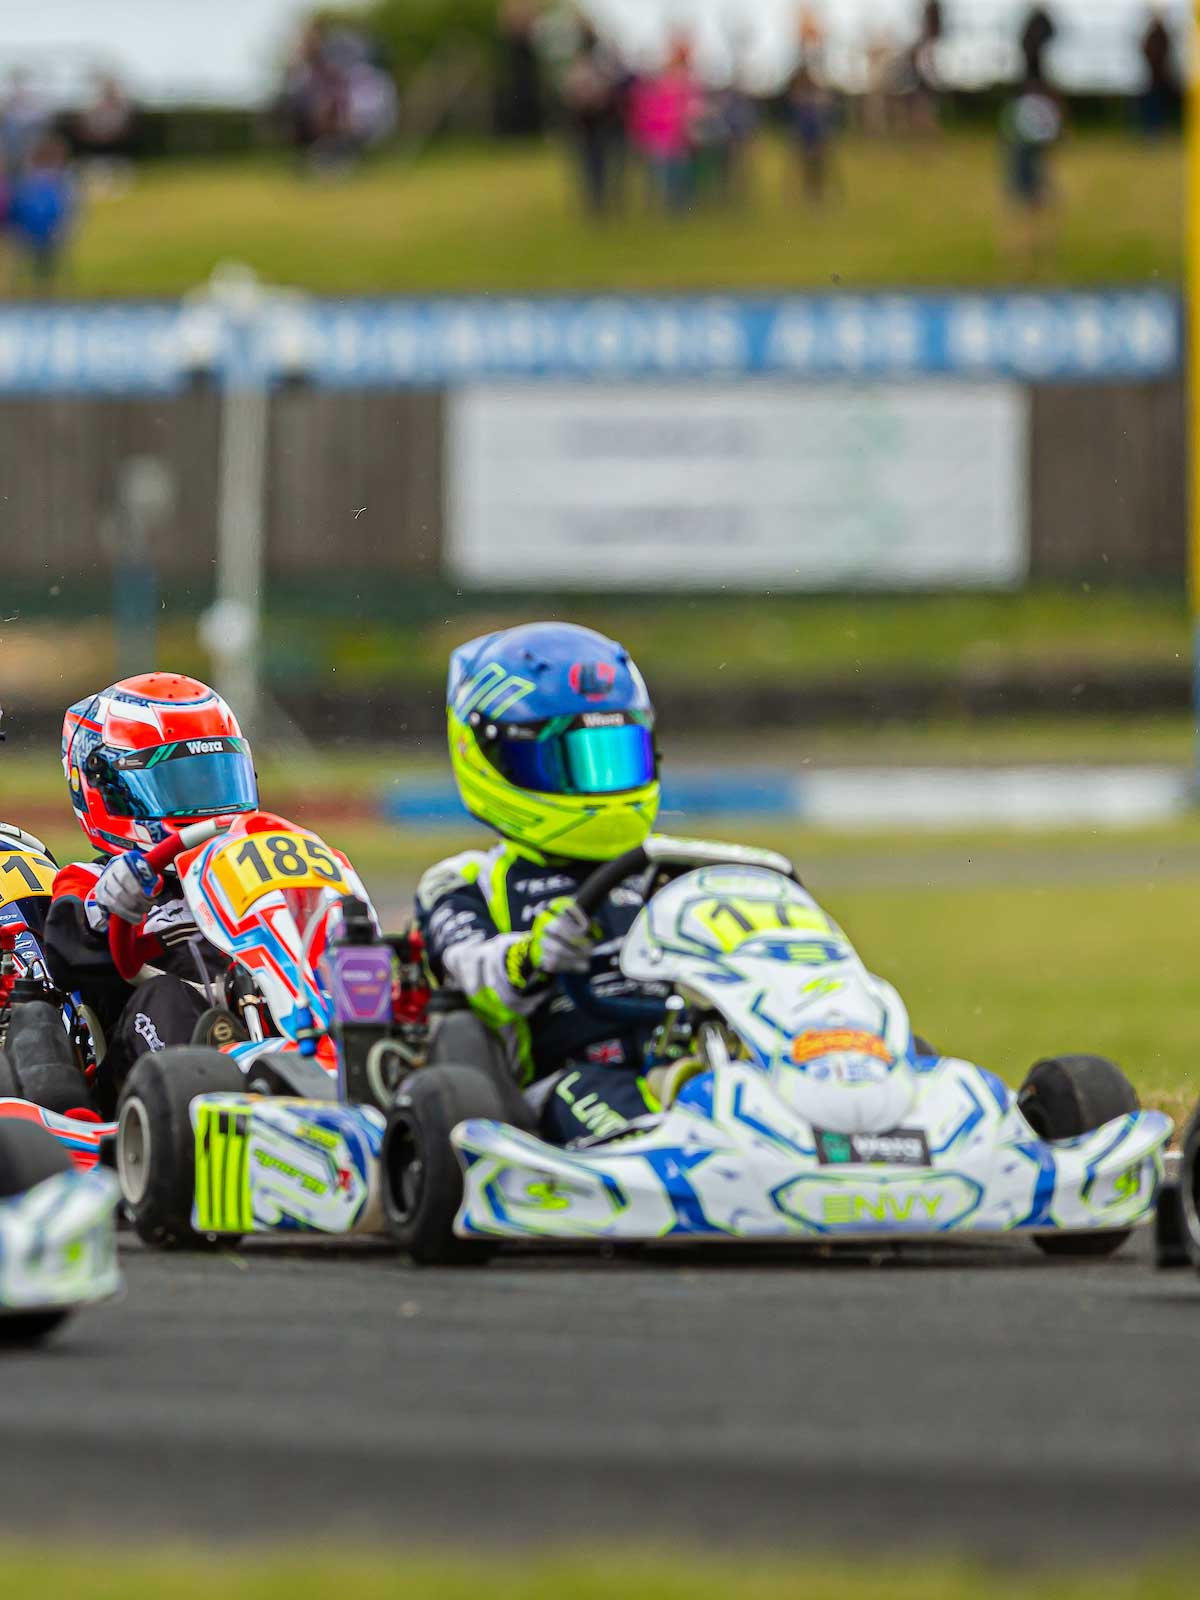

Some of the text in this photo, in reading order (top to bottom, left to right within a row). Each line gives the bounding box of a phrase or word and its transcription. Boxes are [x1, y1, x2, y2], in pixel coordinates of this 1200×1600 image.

[186, 740, 224, 755] Wera
[235, 836, 342, 882] 185
[823, 1195, 942, 1224] ENVY
